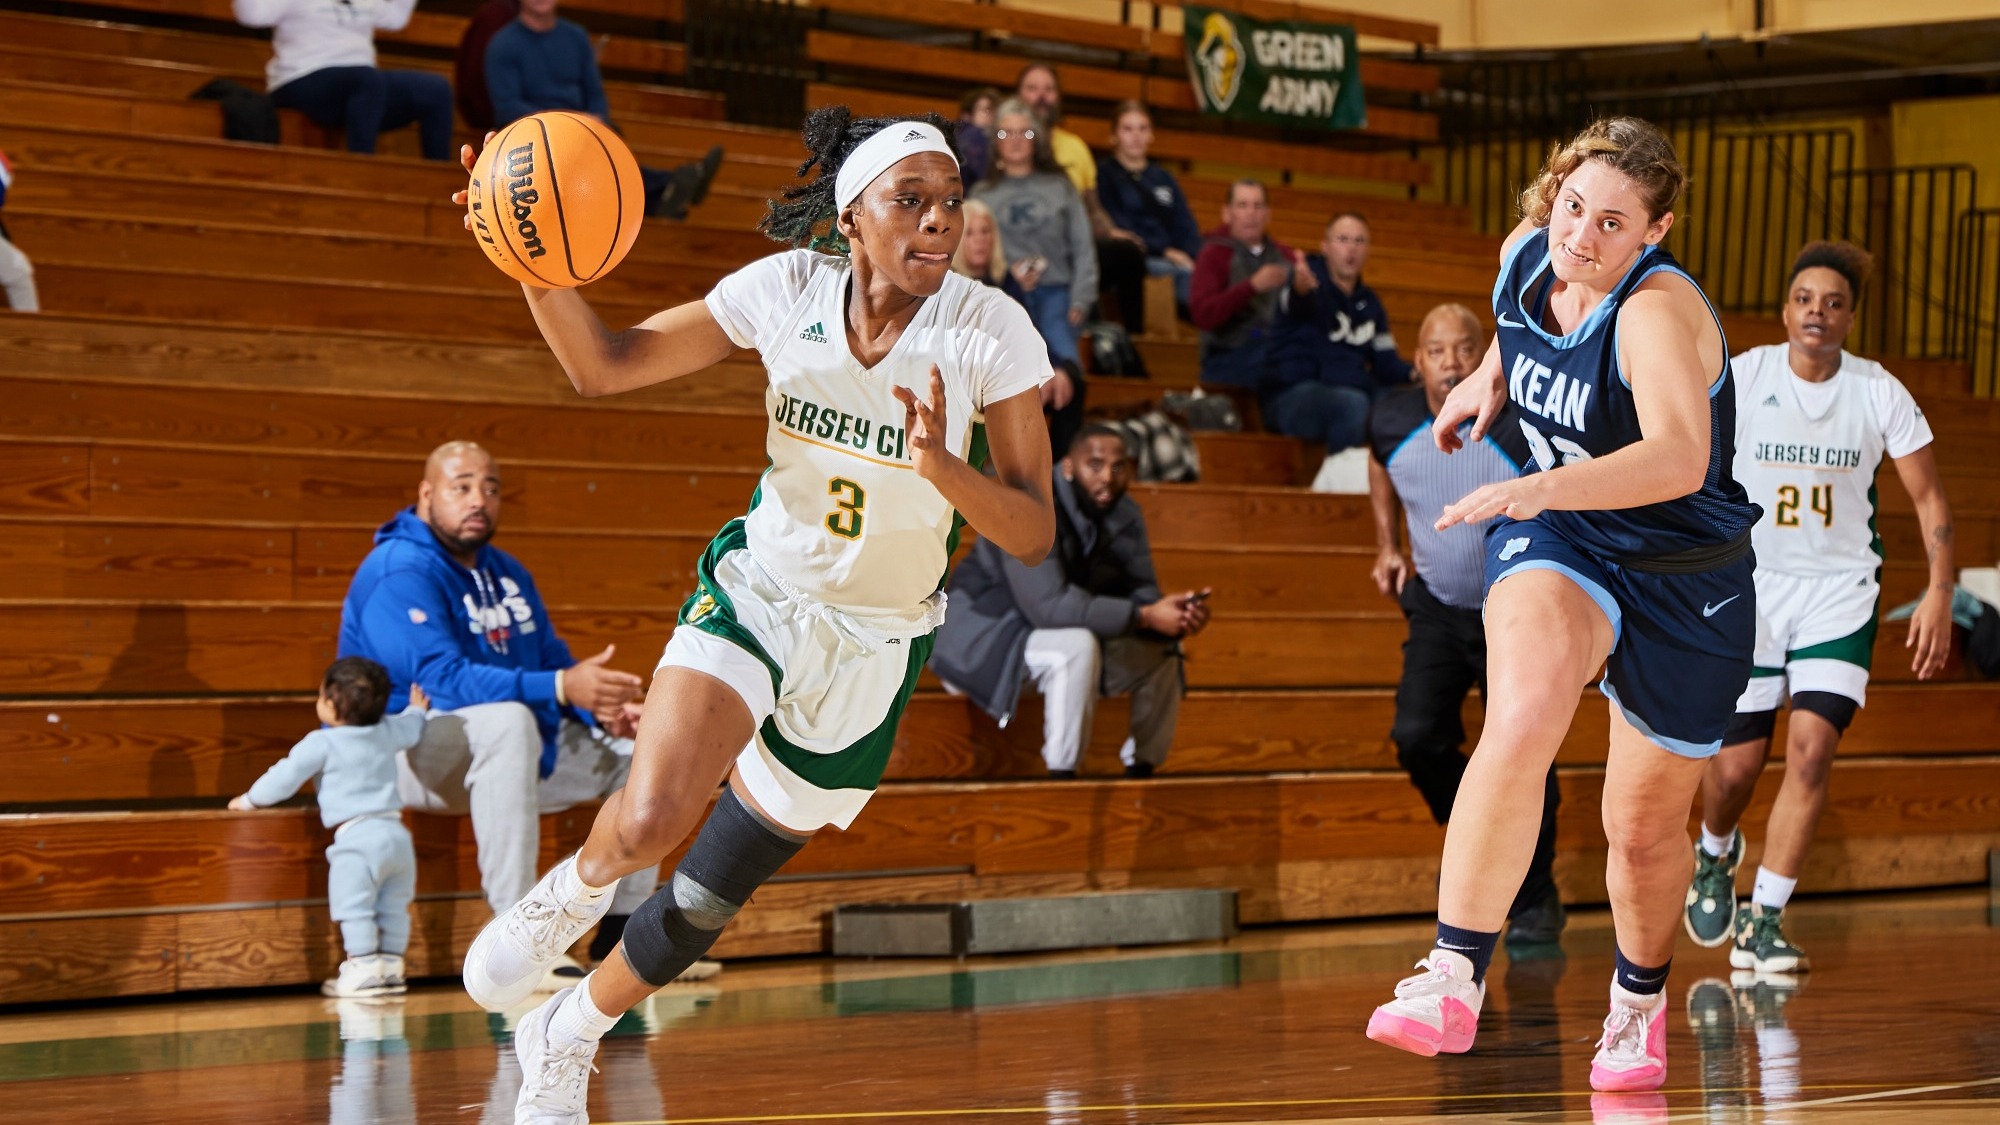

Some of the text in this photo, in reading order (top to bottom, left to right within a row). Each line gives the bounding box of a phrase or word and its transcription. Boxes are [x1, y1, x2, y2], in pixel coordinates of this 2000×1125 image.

[1252, 30, 1344, 72] GREEN
[1259, 75, 1340, 118] ARMY
[505, 142, 547, 260] Wilson
[799, 332, 828, 344] adidas
[1509, 352, 1592, 433] KEAN
[775, 393, 913, 461] JERSEY CI
[1755, 443, 1861, 468] JERSEY CITY
[824, 475, 867, 542] 3
[1776, 483, 1834, 529] 24
